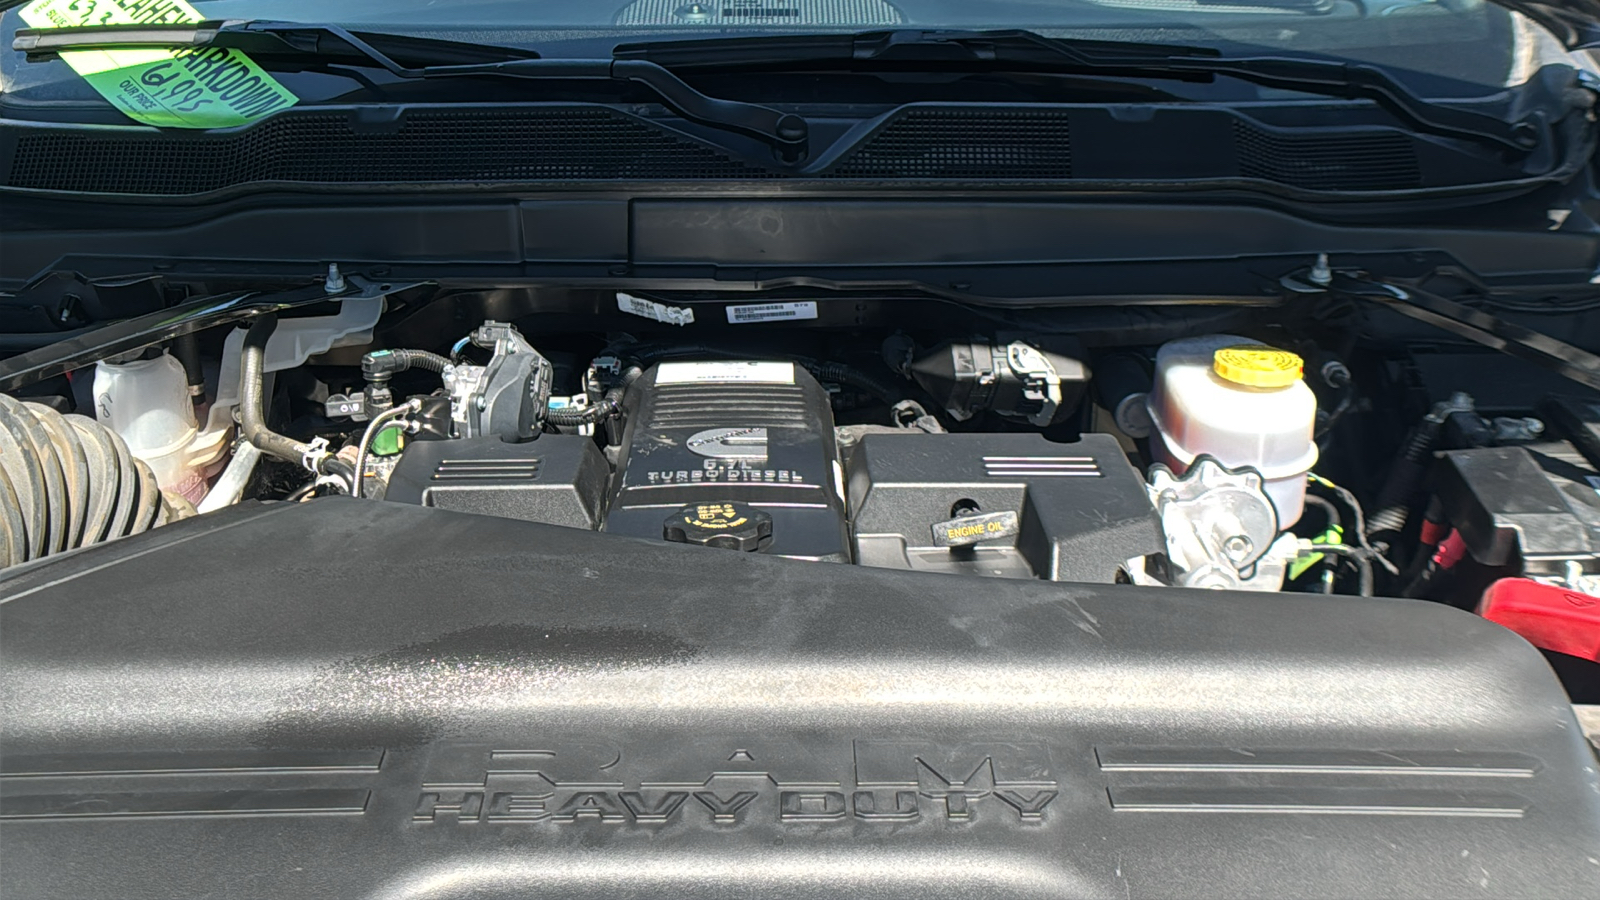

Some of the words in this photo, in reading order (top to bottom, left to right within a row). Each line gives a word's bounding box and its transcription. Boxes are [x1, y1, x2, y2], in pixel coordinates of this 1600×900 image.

[119, 79, 139, 96] OUR
[136, 92, 157, 110] PRICE
[648, 470, 719, 482] TURBO
[727, 469, 803, 482] DIESEL
[947, 524, 985, 539] ENGINE
[987, 521, 1004, 532] OIL
[412, 791, 759, 823] HEAVY
[780, 791, 1060, 821] DUTY
